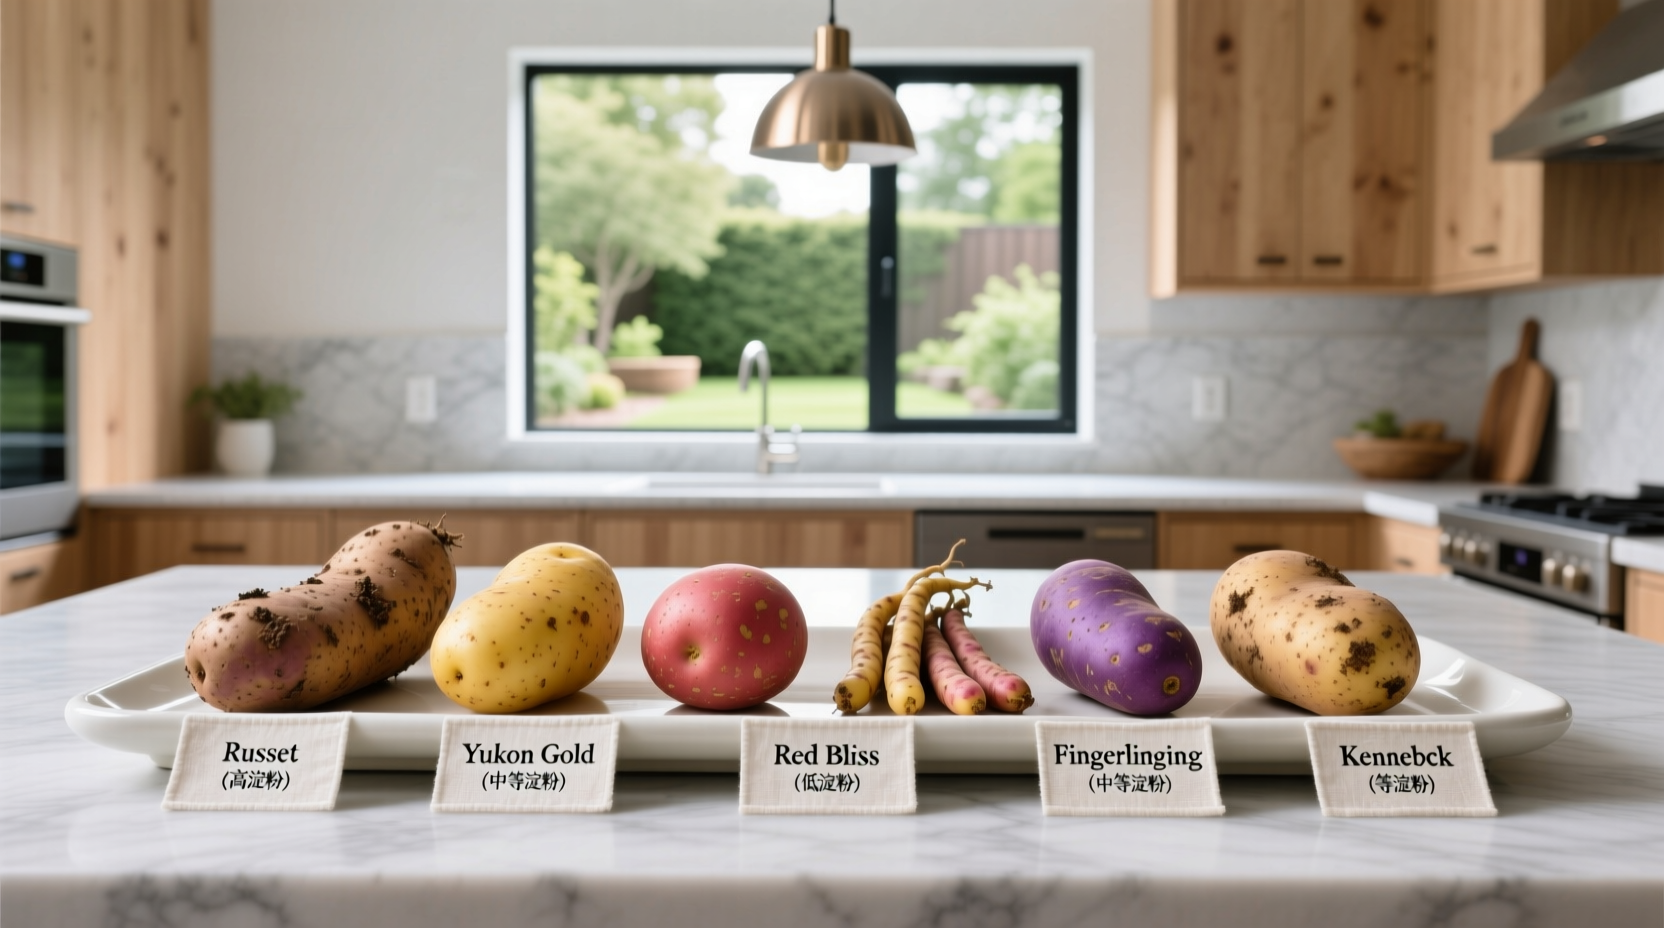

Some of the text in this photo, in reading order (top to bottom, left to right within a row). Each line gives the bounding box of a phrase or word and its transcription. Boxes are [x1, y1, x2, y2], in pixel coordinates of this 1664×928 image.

[222, 741, 299, 763] Russet
[462, 743, 595, 764] Yukon Gold
[774, 743, 880, 766] Red Bliss
[1053, 743, 1203, 771] Fingerlinging
[1339, 745, 1454, 766] Kennebck
